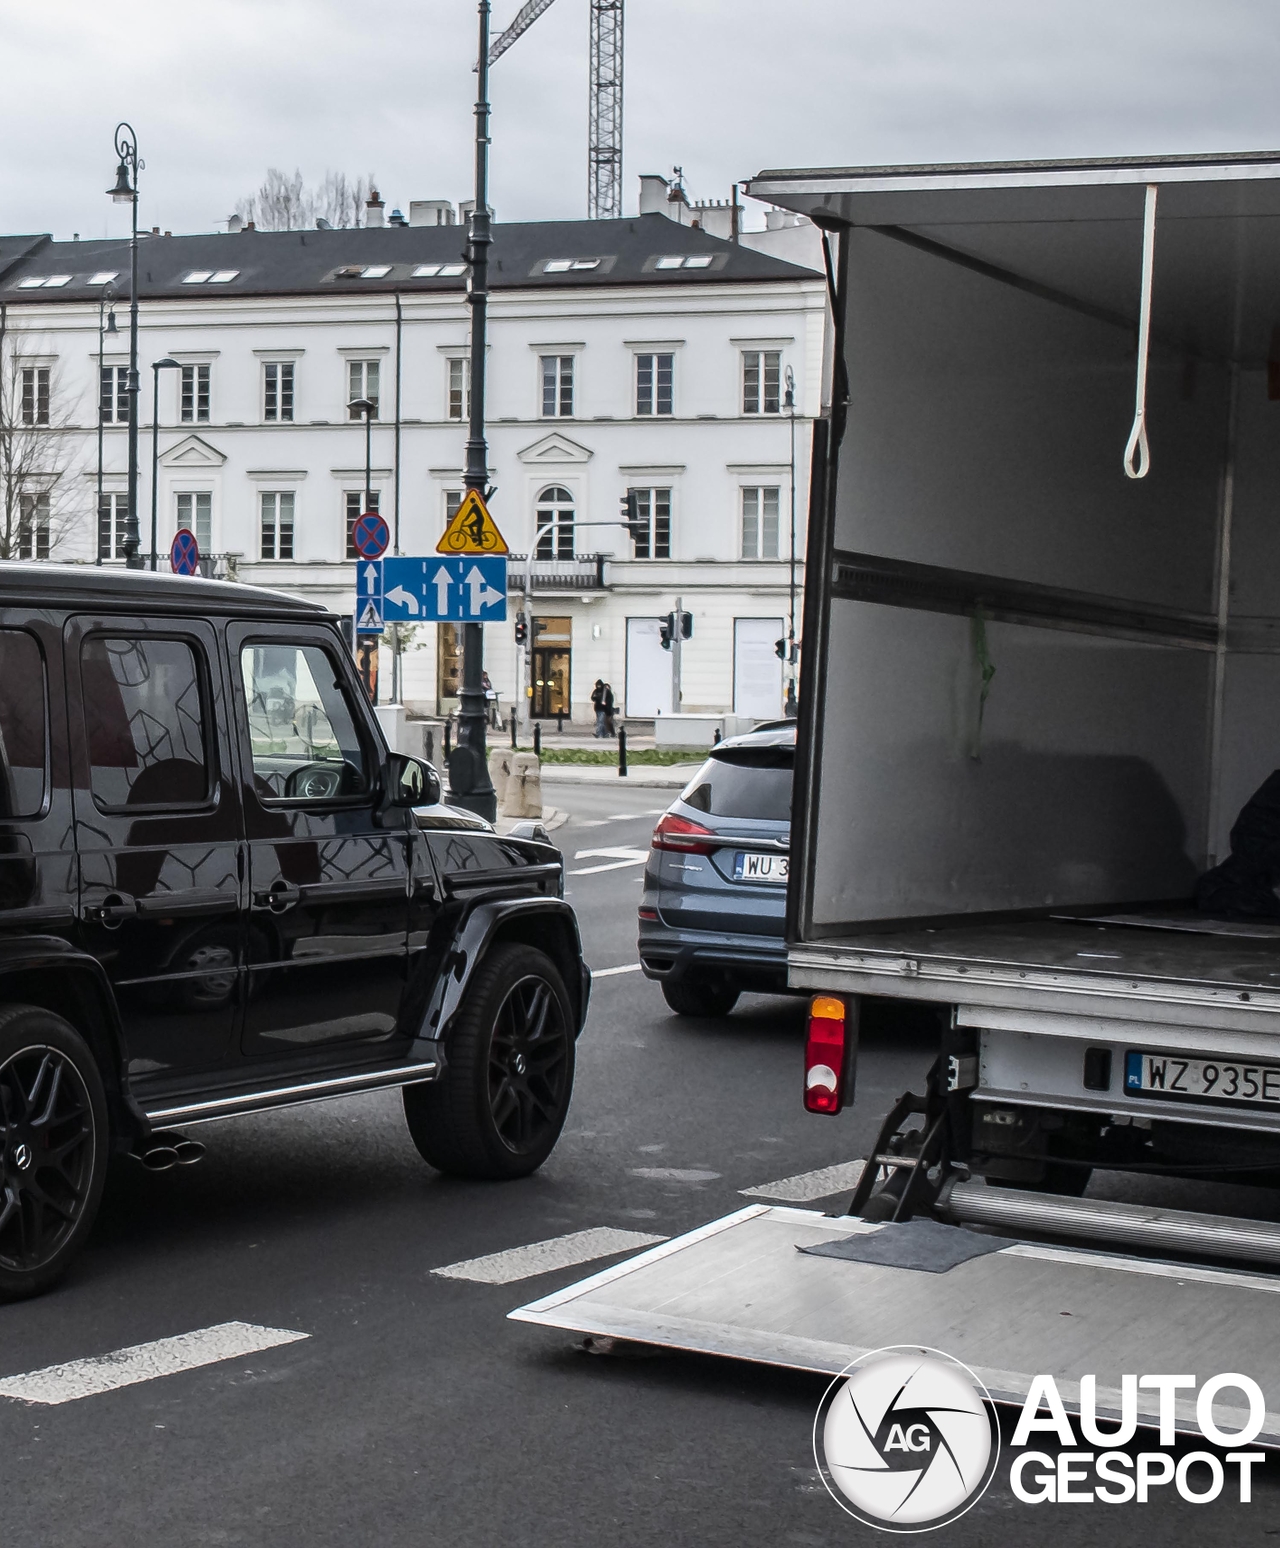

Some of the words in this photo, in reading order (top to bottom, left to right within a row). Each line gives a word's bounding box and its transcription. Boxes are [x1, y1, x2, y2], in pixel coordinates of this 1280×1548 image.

[748, 856, 772, 875] WU
[1128, 1075, 1140, 1085] PL
[1149, 1058, 1189, 1092] WZ
[1202, 1064, 1280, 1100] 935E
